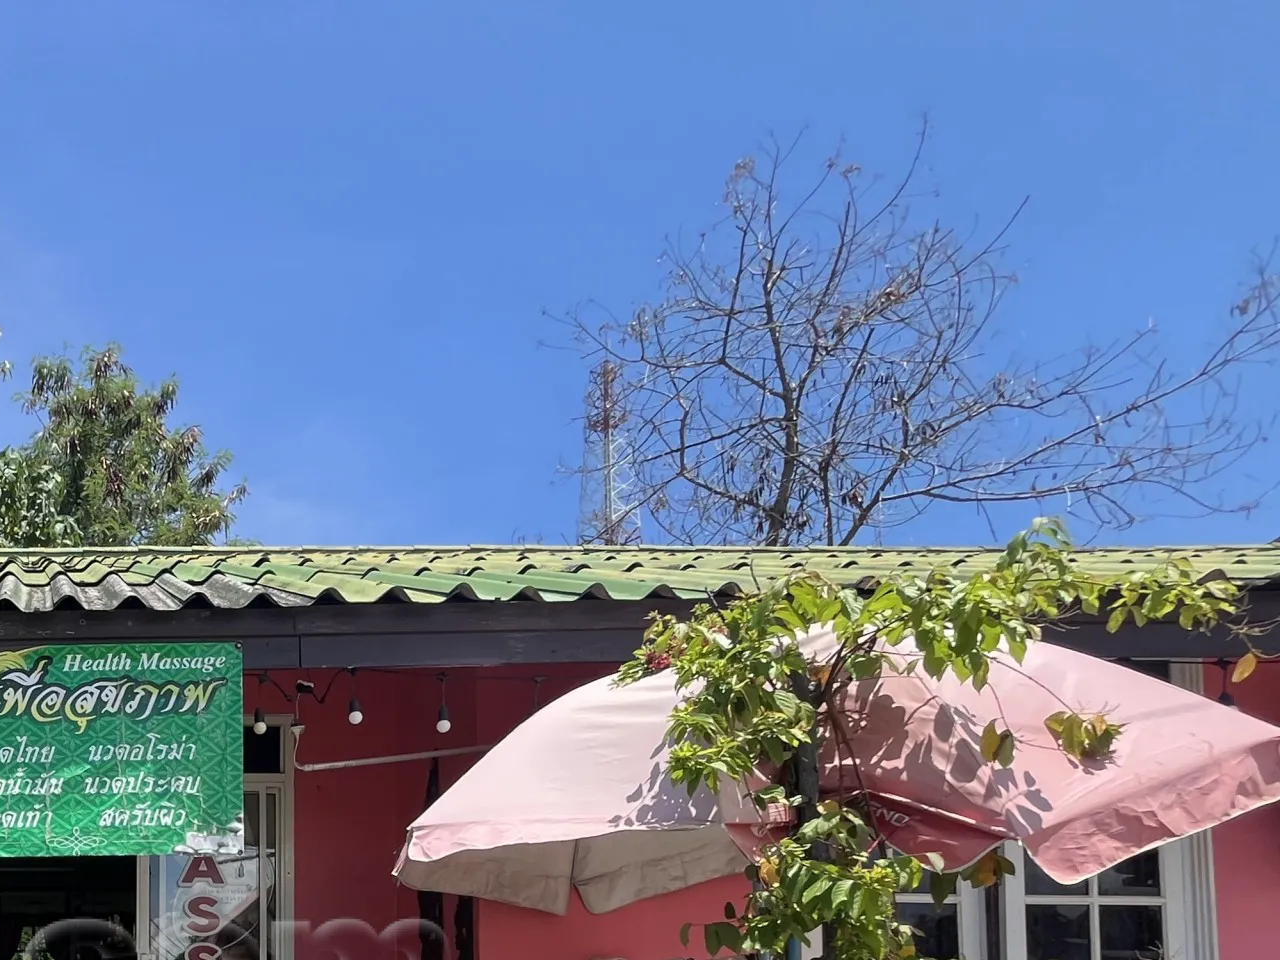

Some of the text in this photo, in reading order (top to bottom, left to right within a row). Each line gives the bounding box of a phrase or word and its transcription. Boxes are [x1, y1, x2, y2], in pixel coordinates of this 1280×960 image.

[63, 652, 227, 674] Health Massage
[88, 732, 197, 762] นวดอโรม่า
[84, 771, 201, 796] นวดประคบ
[98, 802, 187, 828] สครับผิว
